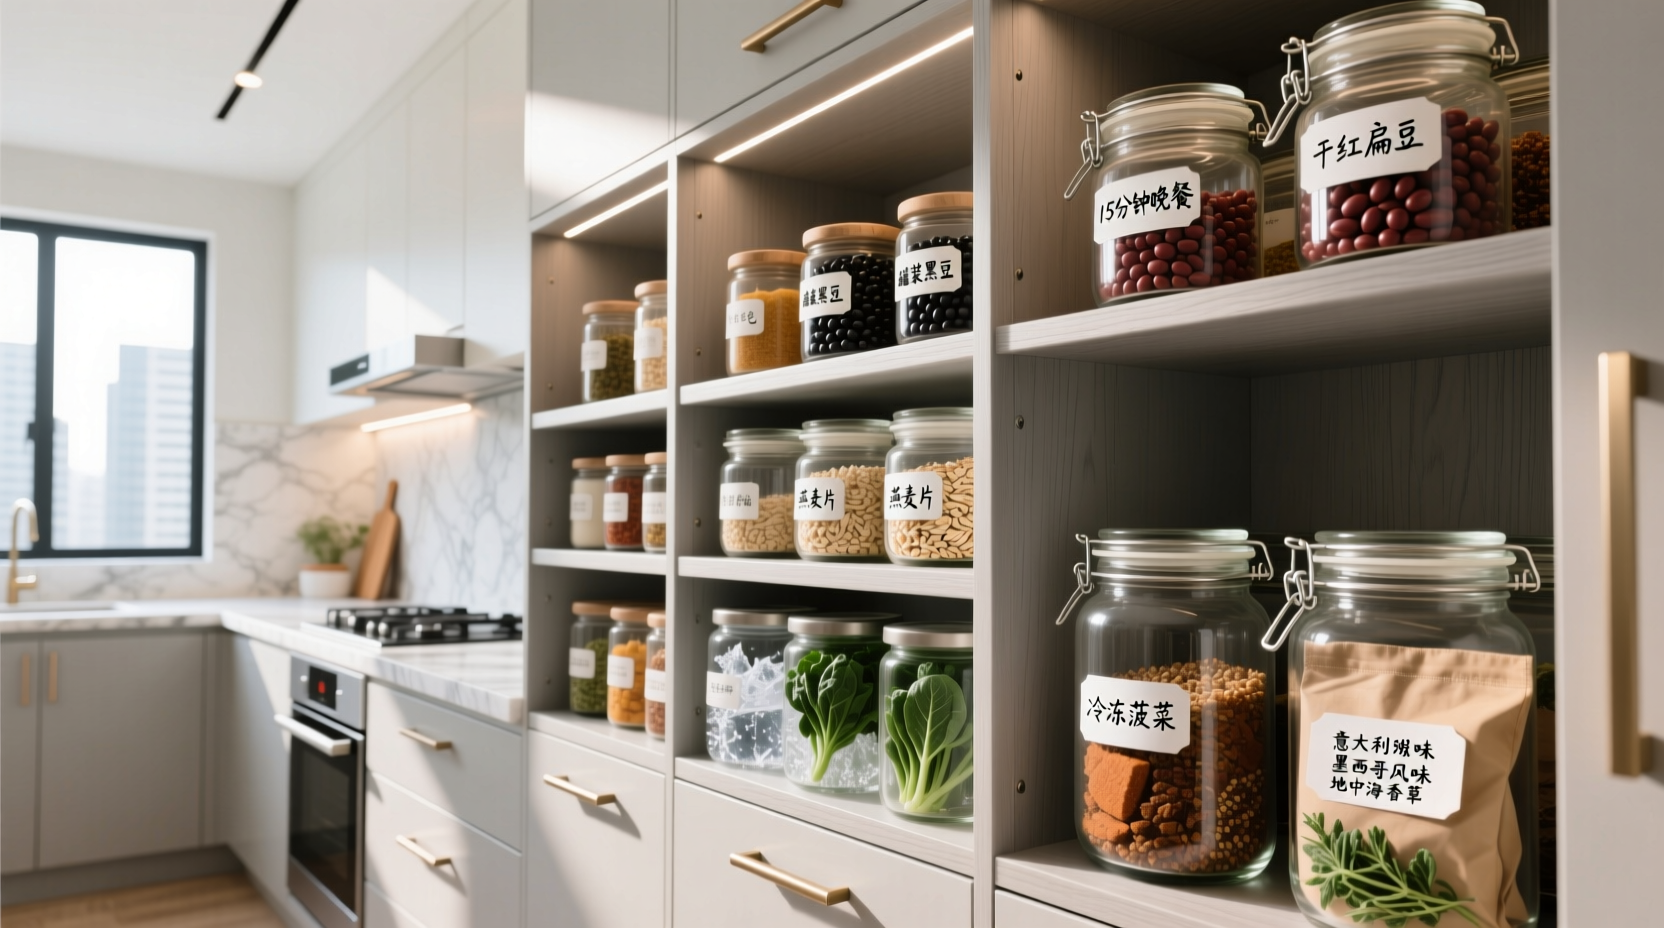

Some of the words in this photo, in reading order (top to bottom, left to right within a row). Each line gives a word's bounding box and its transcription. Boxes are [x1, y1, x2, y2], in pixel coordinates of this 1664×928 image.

[1313, 119, 1424, 169] 干红扁豆
[1100, 181, 1194, 224] 15分钟晚餐
[1086, 696, 1176, 731] 冷冻菠菜
[1332, 754, 1432, 785] 墨西哥风味
